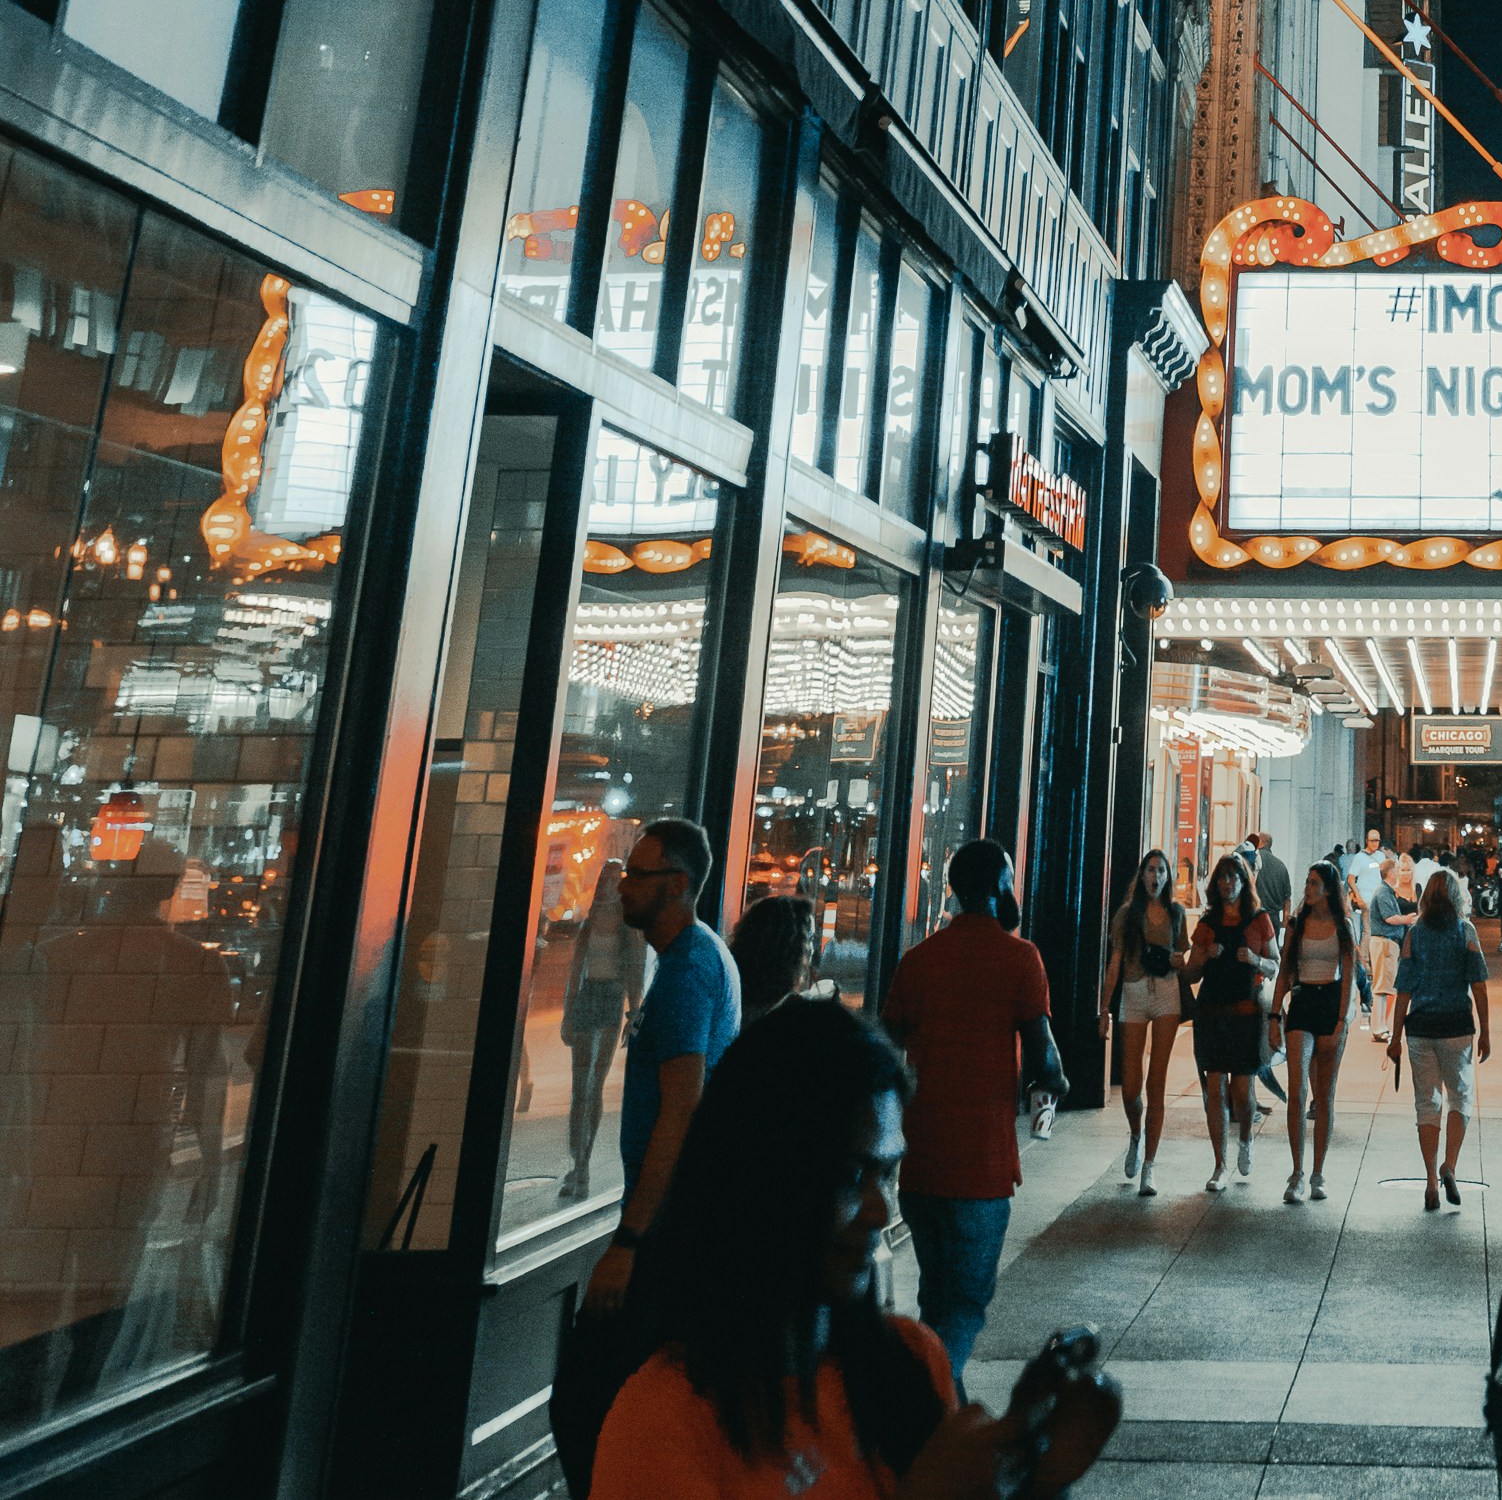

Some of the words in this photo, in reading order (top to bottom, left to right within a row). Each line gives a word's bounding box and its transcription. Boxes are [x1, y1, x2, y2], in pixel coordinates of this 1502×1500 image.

[1232, 363, 1397, 417] MOM'S
[1429, 731, 1484, 741] CHICAGO
[1428, 746, 1464, 755] MARQUEE
[1465, 746, 1485, 755] TOUR
